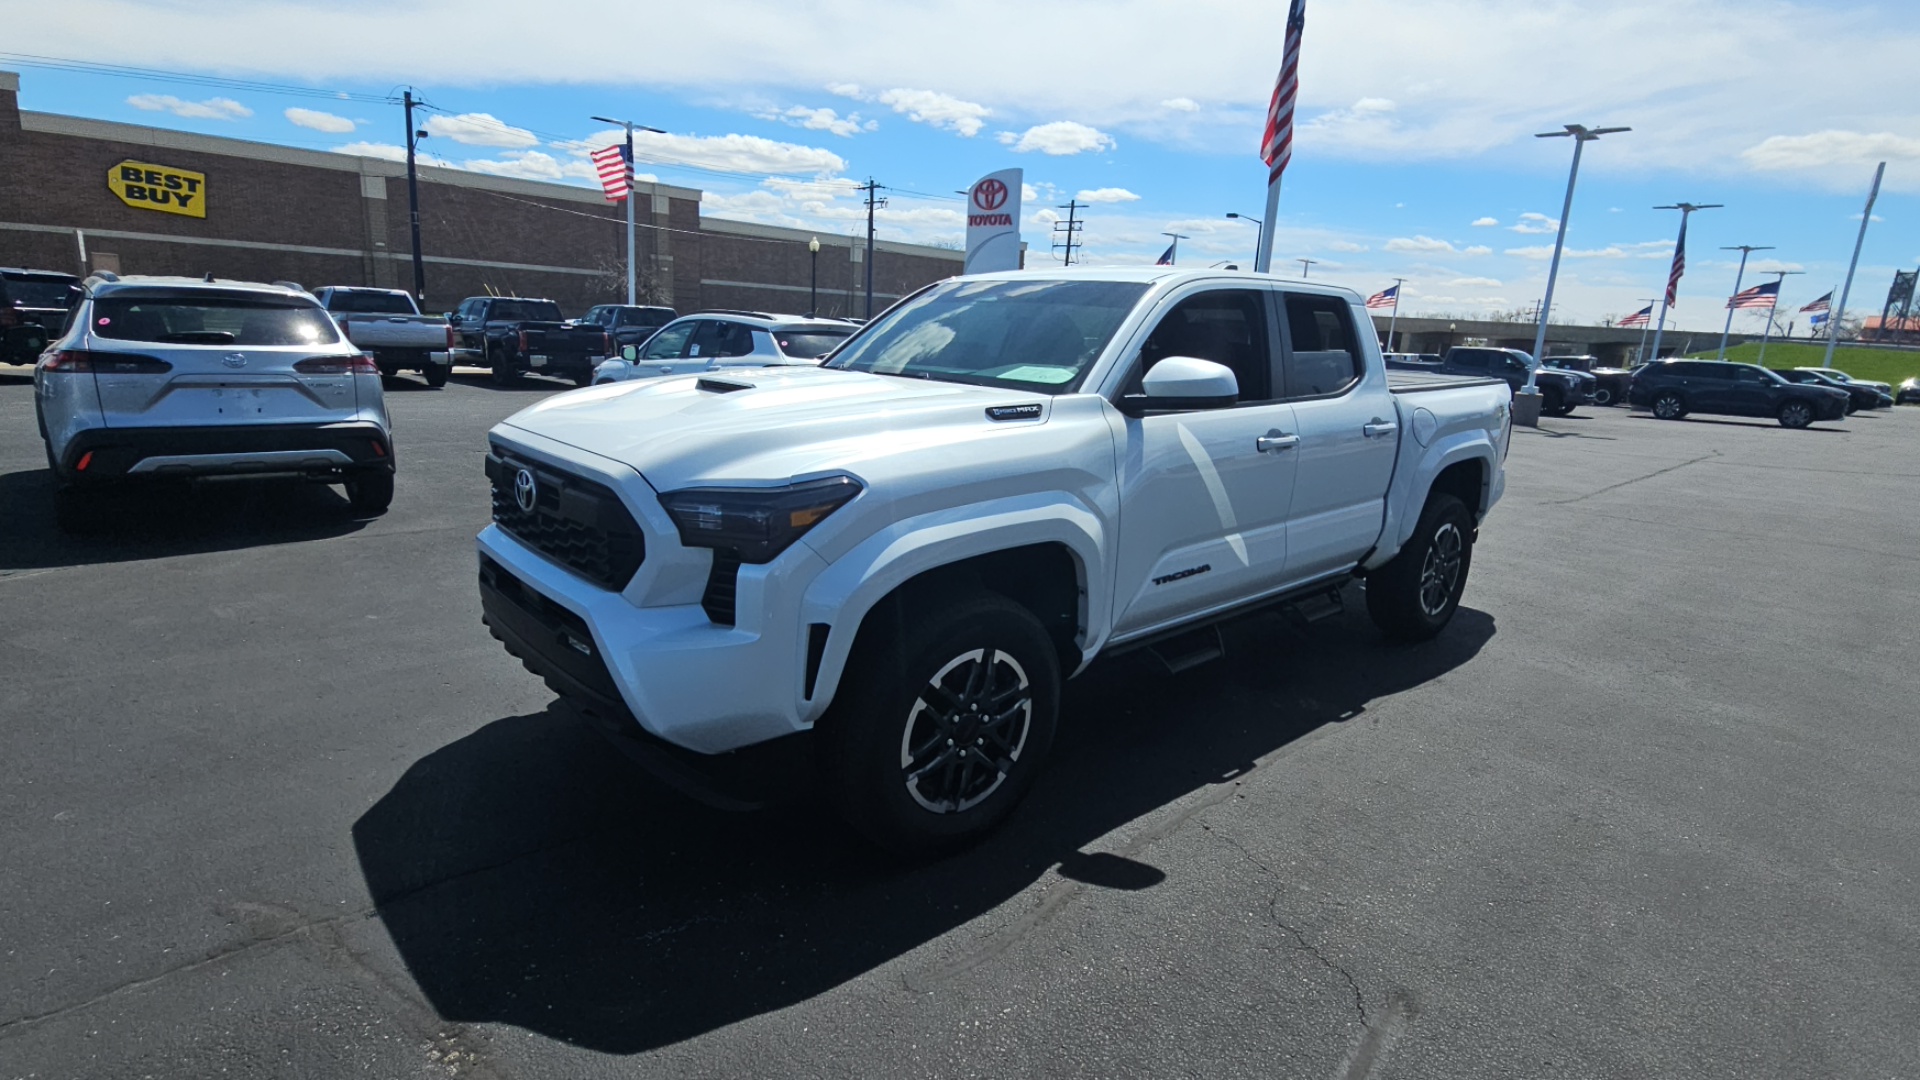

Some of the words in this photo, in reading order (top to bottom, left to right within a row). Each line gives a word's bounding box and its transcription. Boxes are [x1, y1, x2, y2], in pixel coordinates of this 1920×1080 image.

[121, 166, 201, 193] BEST
[125, 184, 194, 208] BUY
[968, 214, 1012, 226] TOYOTA
[1152, 564, 1211, 585] TACOMA
